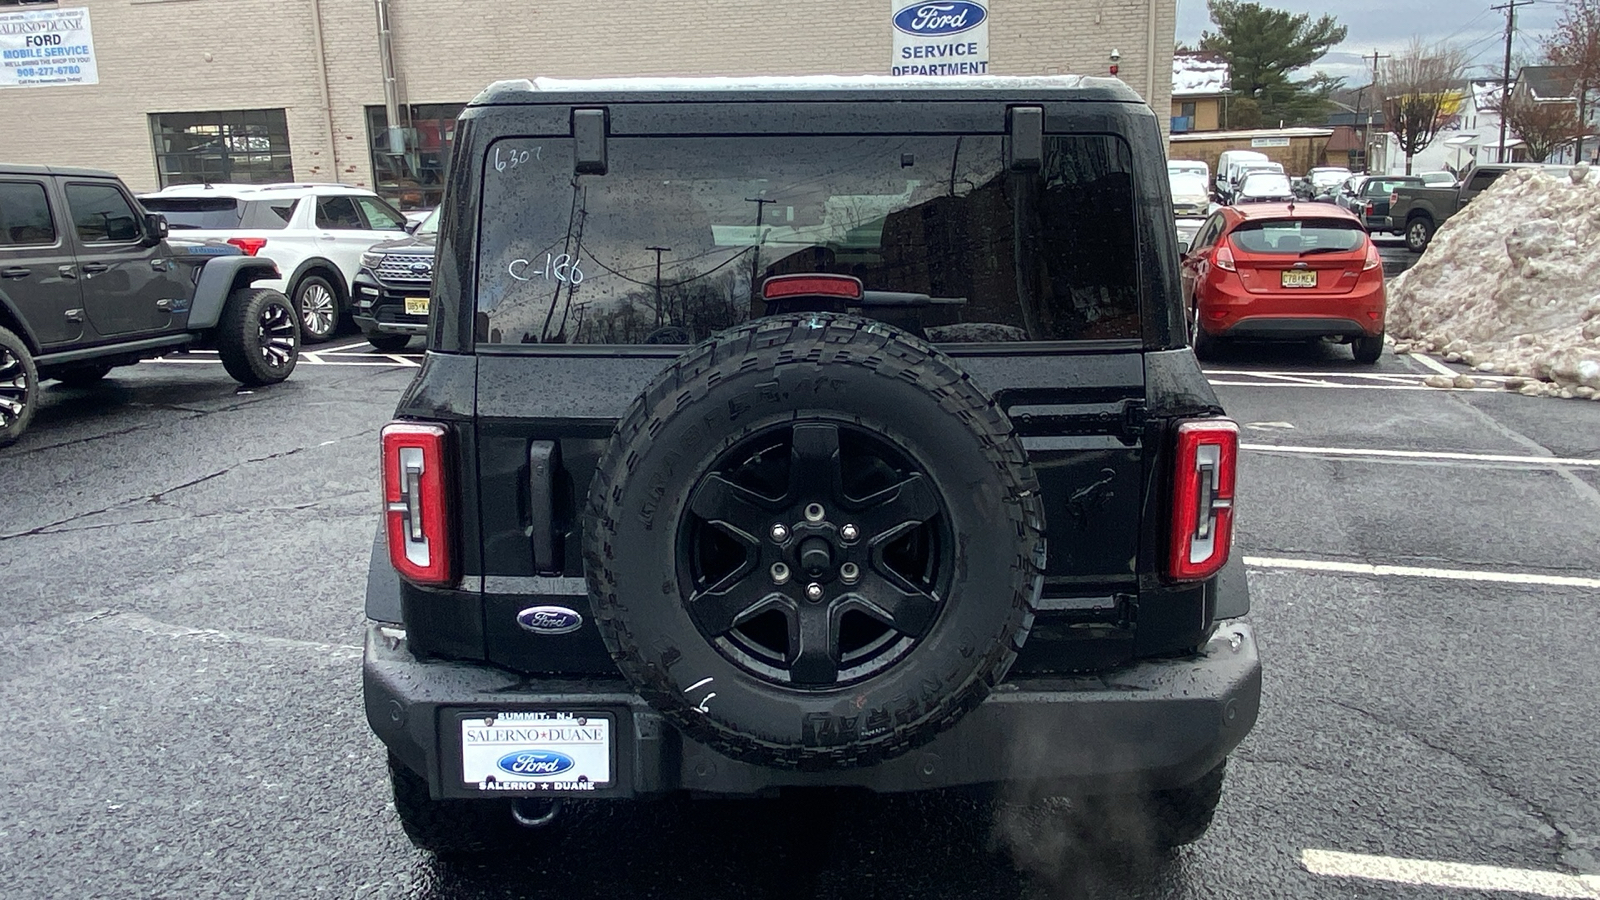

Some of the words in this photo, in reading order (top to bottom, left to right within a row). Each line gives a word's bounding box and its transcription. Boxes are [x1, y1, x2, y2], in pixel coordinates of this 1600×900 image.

[911, 4, 969, 30] Ford
[0, 20, 41, 35] ALERNO
[46, 18, 83, 32] DUANE
[26, 34, 62, 47] FORD
[3, 48, 42, 59] MOBILE
[44, 45, 89, 57] SERVICE
[902, 42, 978, 59] SERVICE
[892, 61, 988, 76] DEPARTMENT
[508, 253, 584, 284] C-186
[532, 611, 567, 627] Ford
[557, 712, 573, 720] NJ
[467, 729, 539, 742] SALERNO
[548, 728, 604, 742] DUANE
[512, 754, 559, 772] Ford
[479, 781, 536, 790] SALERNO
[554, 781, 595, 790] DUANE
